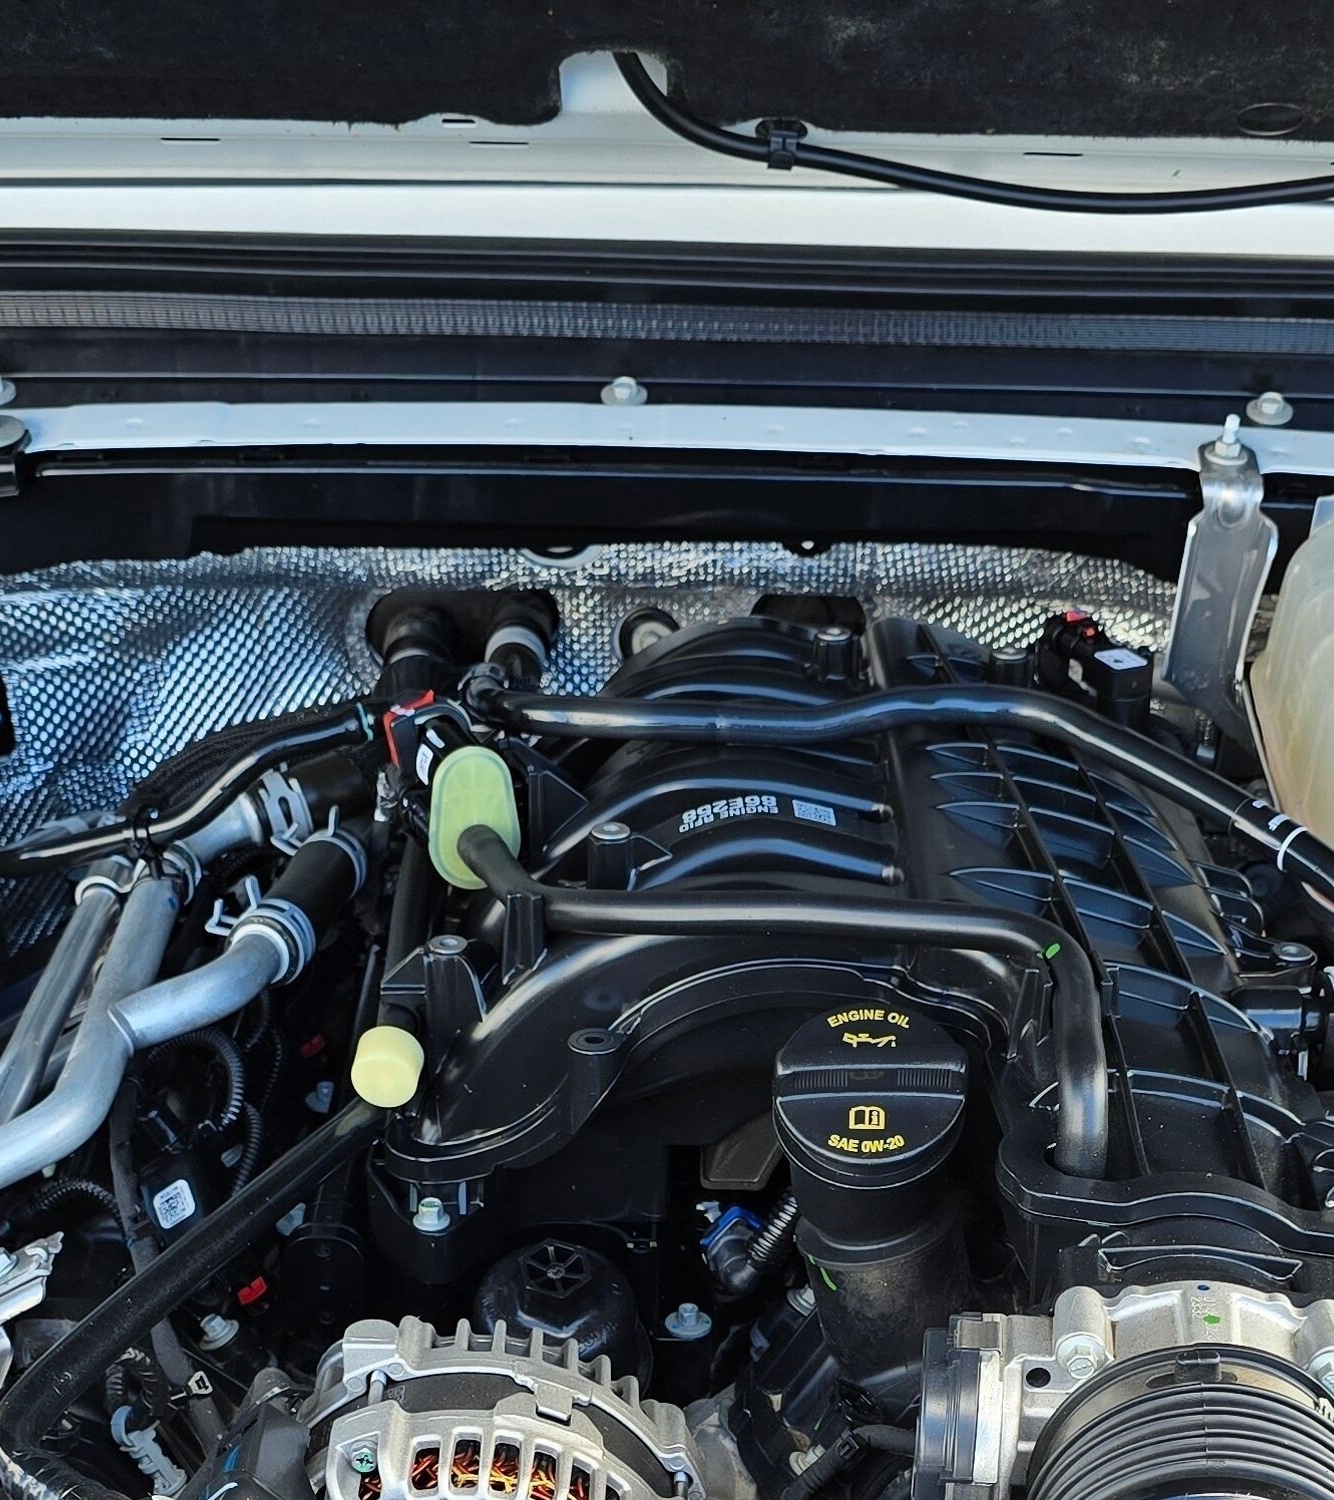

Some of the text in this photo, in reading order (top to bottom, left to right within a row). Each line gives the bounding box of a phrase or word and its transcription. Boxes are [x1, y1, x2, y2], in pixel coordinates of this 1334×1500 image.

[720, 805, 779, 820] ENGINE
[827, 1009, 910, 1029] ENGINE OIL
[828, 1134, 905, 1153] SAE 0W-20
